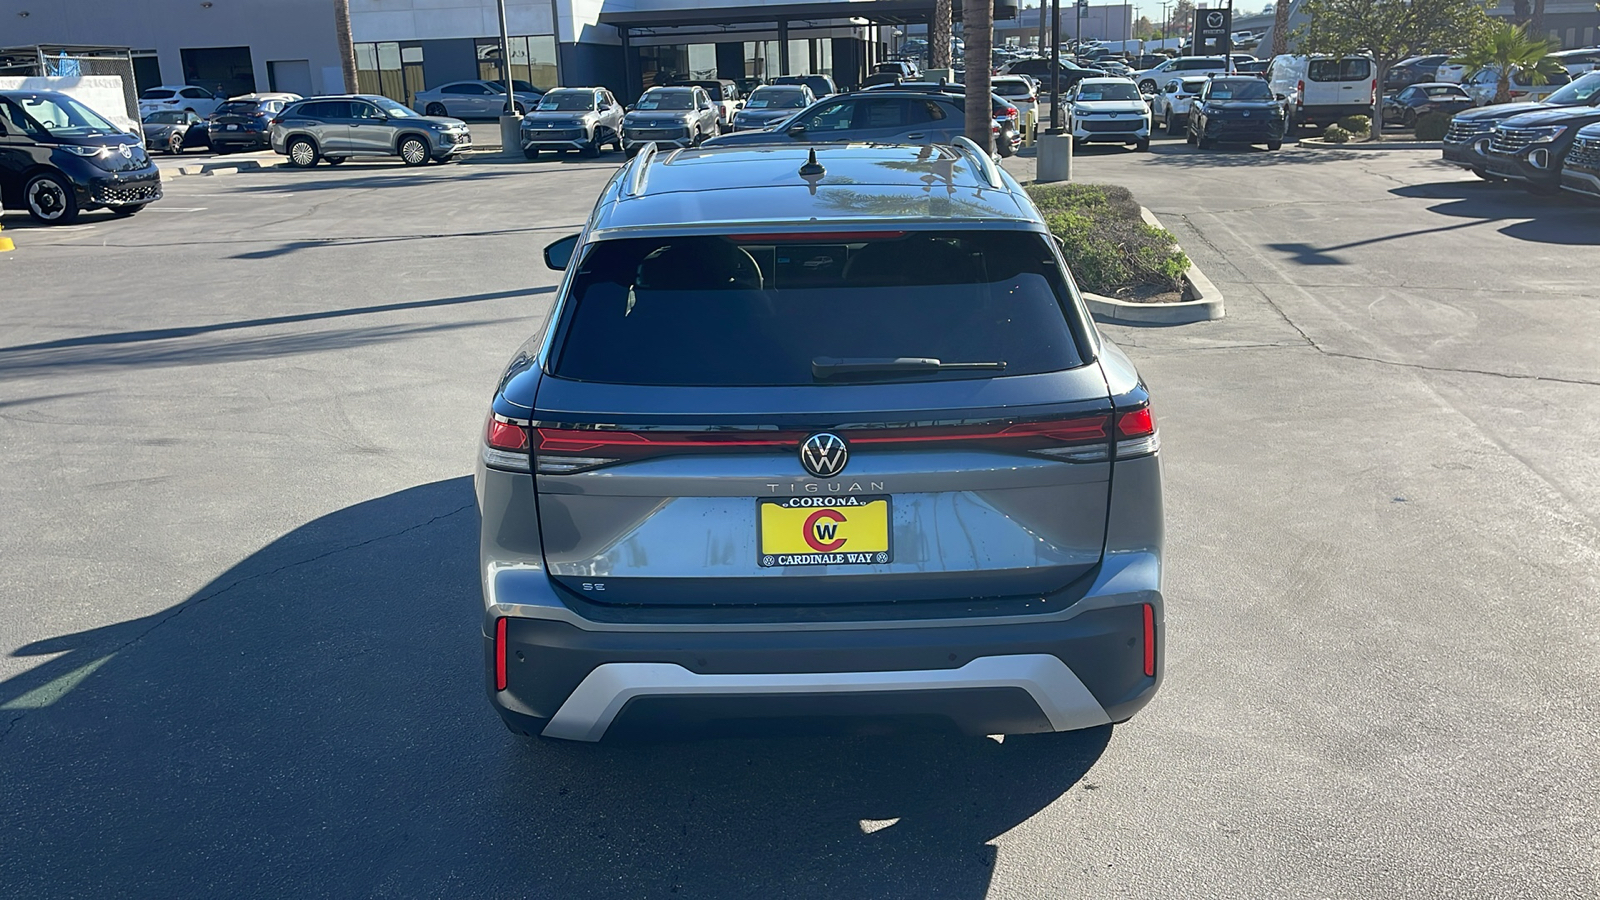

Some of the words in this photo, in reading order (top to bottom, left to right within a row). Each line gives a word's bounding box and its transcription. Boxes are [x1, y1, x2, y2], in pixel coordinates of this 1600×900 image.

[766, 481, 885, 493] TIGUAN
[789, 496, 858, 507] CORONA
[778, 554, 845, 566] CARDINALE
[846, 553, 873, 565] WAY
[583, 583, 606, 591] SE
